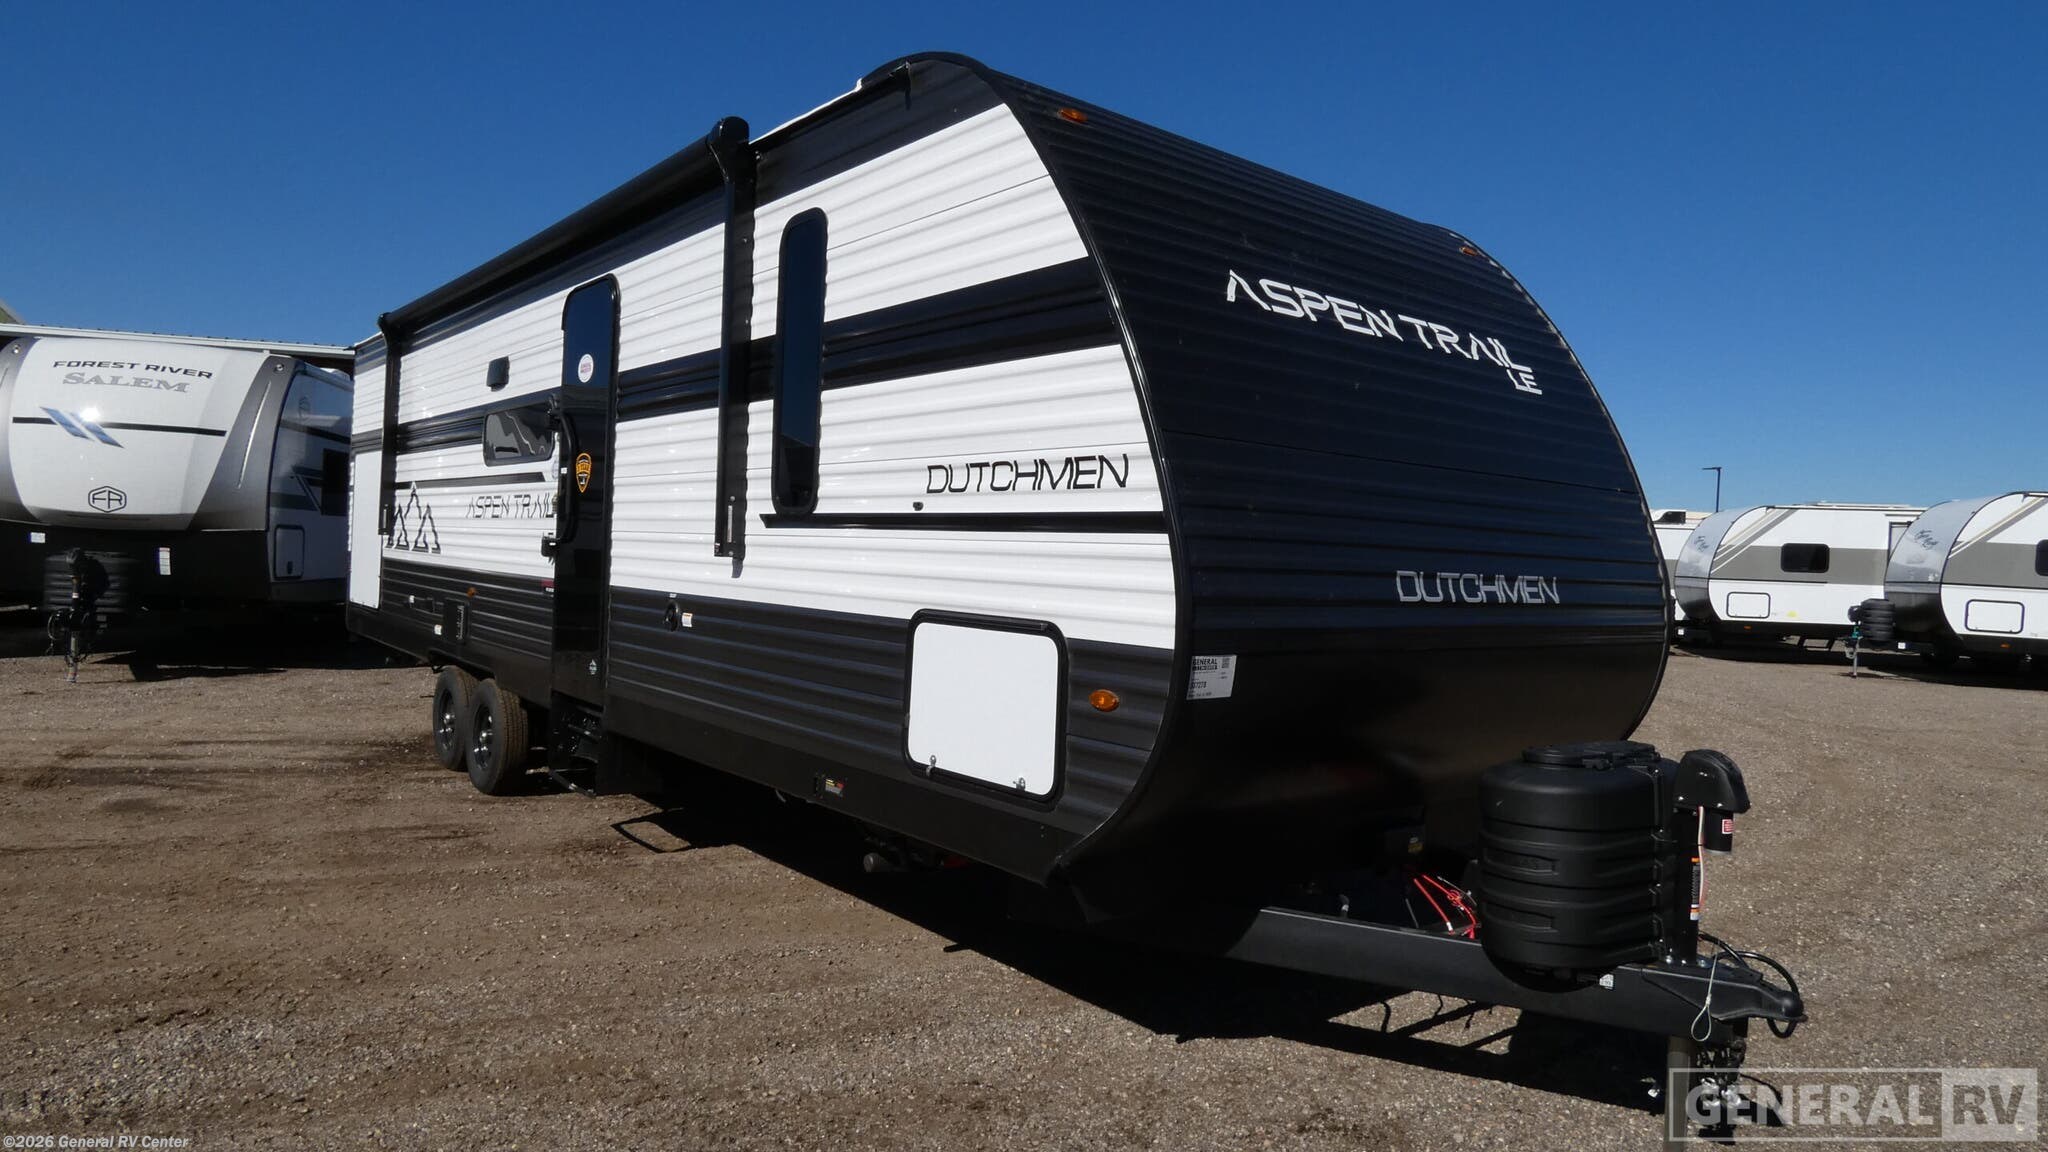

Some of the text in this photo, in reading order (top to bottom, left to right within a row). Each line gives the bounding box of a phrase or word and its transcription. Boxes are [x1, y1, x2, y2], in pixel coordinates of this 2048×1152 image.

[1227, 269, 1533, 374] ASPEN TRAIL
[53, 360, 213, 379] FOREST RIVER
[62, 372, 191, 393] SALEM
[1506, 368, 1543, 395] LE
[926, 453, 1129, 494] DUTCHMEN
[466, 495, 511, 519] ASPEN
[1396, 570, 1560, 604] DUTCHMEN
